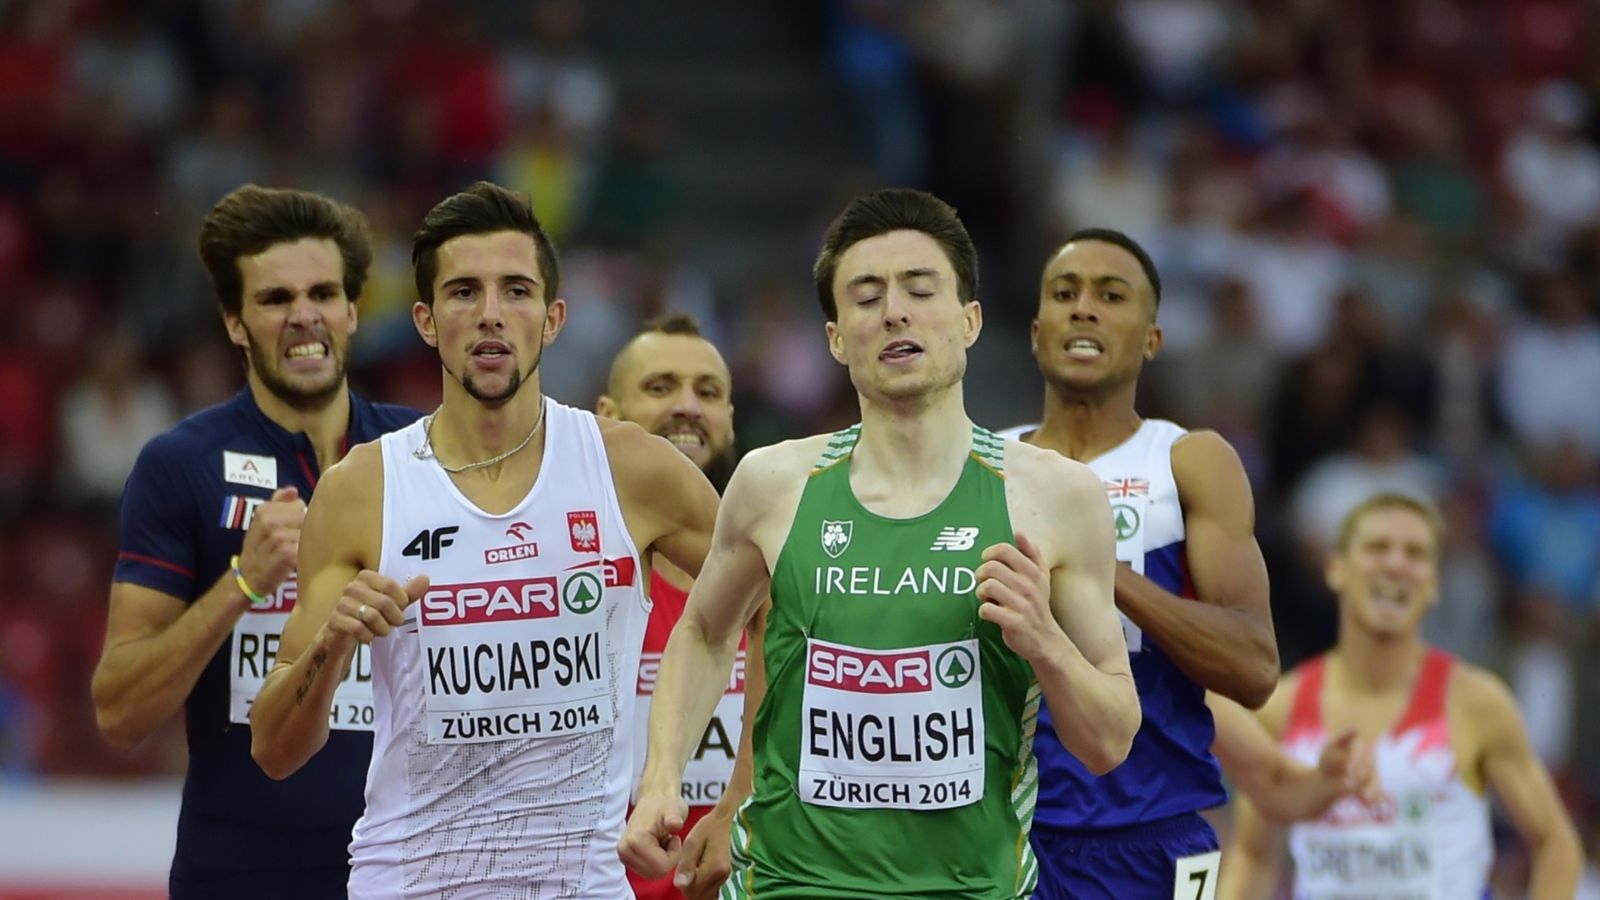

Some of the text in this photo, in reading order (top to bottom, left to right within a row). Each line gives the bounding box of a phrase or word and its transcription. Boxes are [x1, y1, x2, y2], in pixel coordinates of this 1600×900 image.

[229, 473, 272, 486] AREVA
[402, 526, 459, 560] 4F
[487, 545, 536, 563] ORLEN
[815, 566, 976, 594] IRELAND
[424, 584, 555, 620] SPAR
[427, 632, 600, 695] KUCIAPSKI
[812, 652, 928, 688] SPAR
[443, 704, 600, 739] ZÜRICH 2014
[810, 708, 974, 762] ENGLISH
[813, 775, 971, 804] ZÜRICH 2014
[1189, 869, 1208, 900] 7
